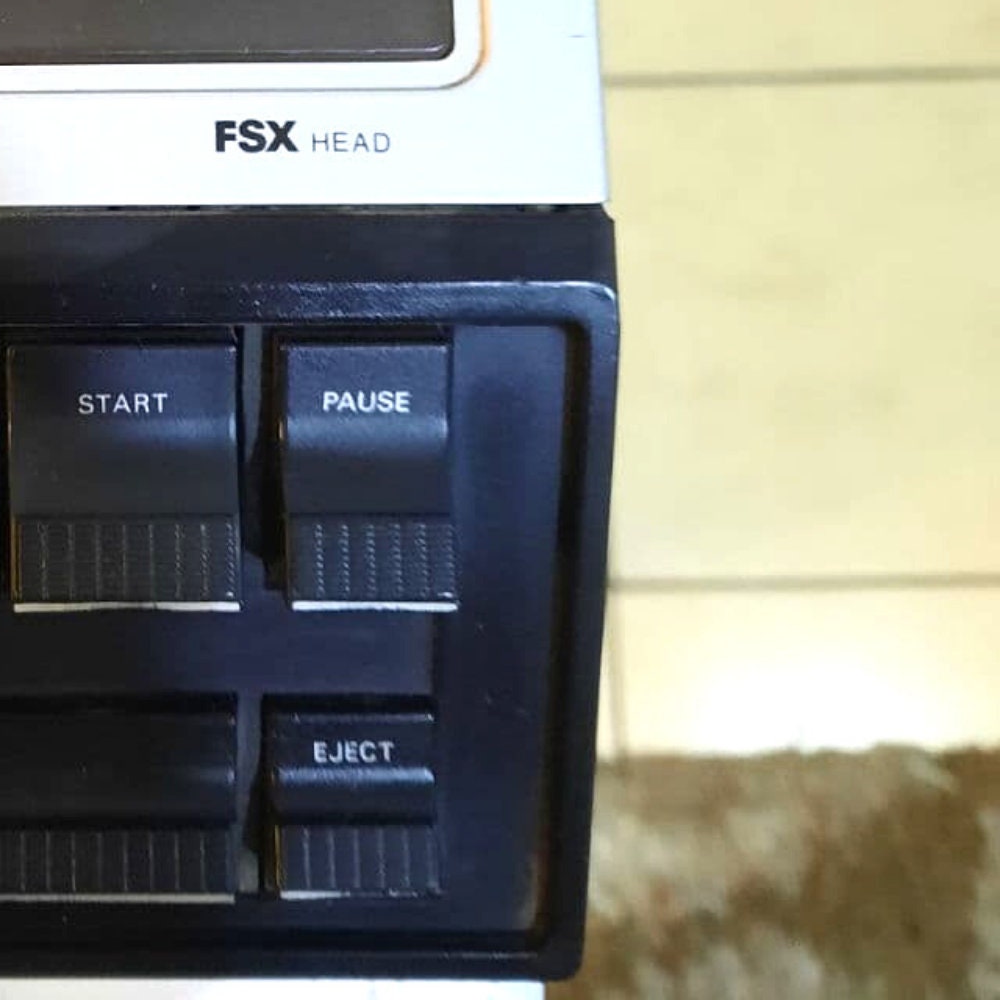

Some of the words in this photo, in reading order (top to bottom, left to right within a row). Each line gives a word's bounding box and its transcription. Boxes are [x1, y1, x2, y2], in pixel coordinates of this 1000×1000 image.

[214, 119, 299, 153] FSX
[311, 132, 391, 153] HEAD
[77, 392, 168, 415] START
[322, 390, 412, 413] PAUSE
[313, 740, 395, 765] EJECT
